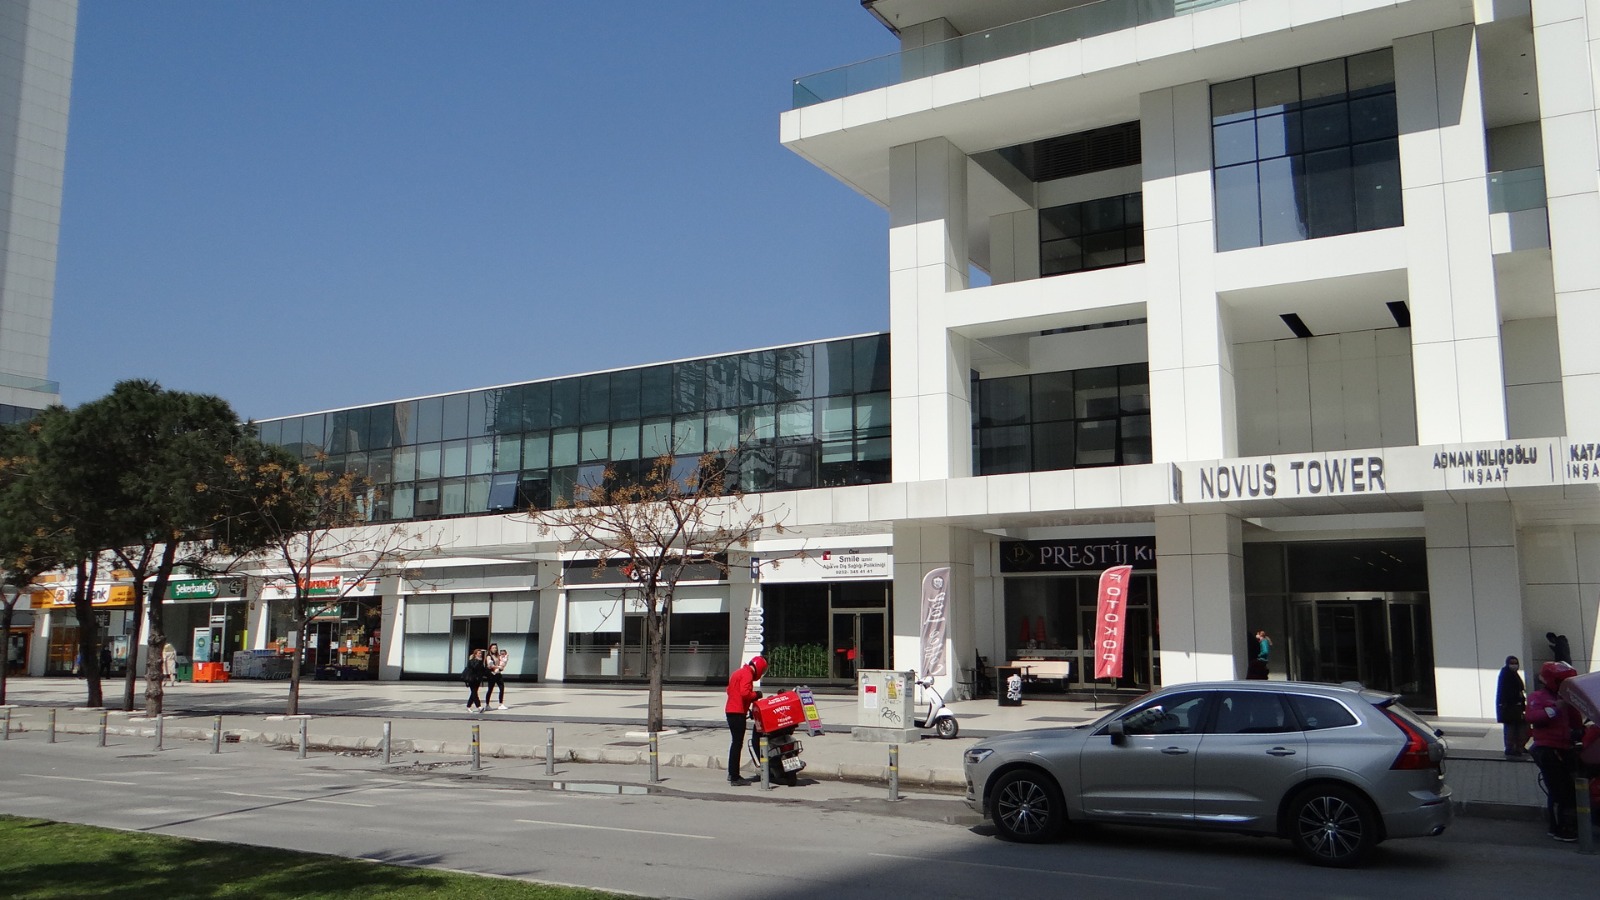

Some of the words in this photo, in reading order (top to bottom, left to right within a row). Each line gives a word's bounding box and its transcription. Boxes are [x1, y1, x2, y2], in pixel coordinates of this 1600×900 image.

[1433, 451, 1473, 469] ADNAN
[1476, 444, 1537, 469] KILIÇOĞLU
[1200, 463, 1276, 499] NOVUS
[1290, 456, 1385, 494] TOWER
[1463, 465, 1509, 485] İNŞAAT
